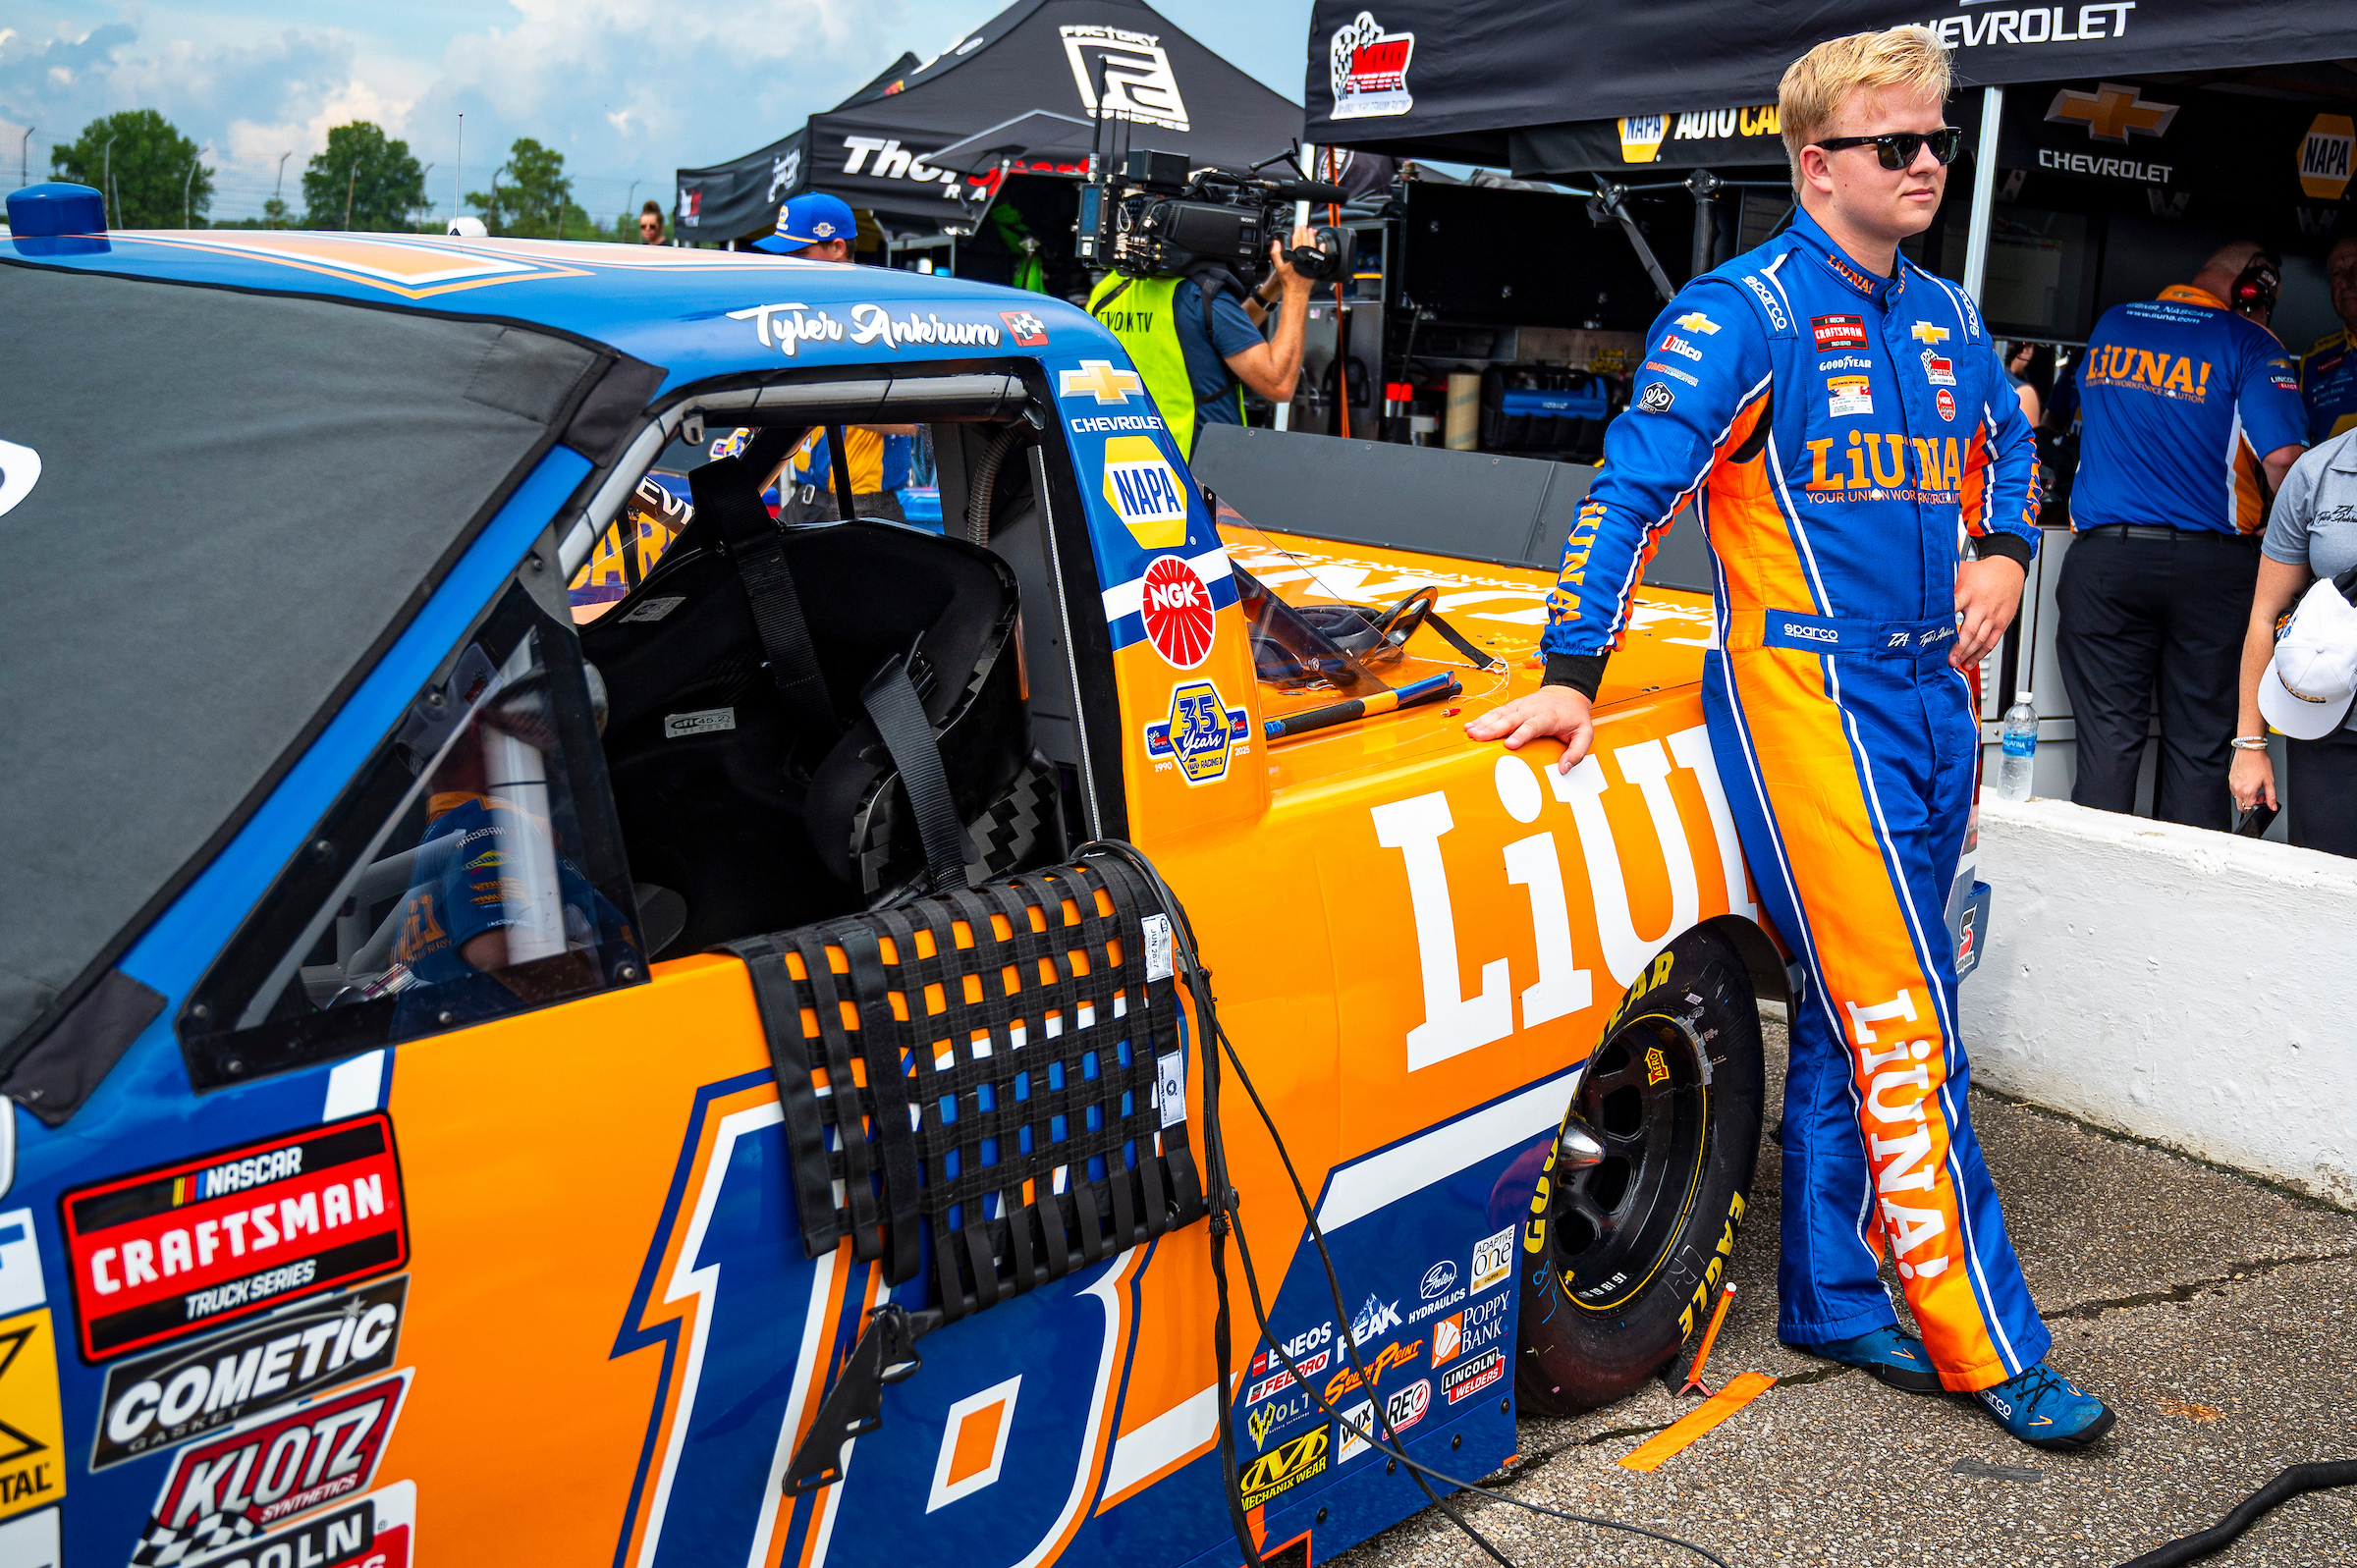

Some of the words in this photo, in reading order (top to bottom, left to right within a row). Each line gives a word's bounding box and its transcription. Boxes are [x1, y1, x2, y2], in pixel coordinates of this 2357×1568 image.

[1059, 26, 1160, 47] FACTORY
[1891, 2, 2135, 50] EVROLET
[1623, 115, 1664, 141] NAPA
[1673, 109, 1737, 140] AUTO
[1739, 105, 1782, 138] CA
[2039, 149, 2172, 184] CHEVROLET
[2303, 136, 2348, 177] NAPA
[1136, 311, 1153, 333] TV
[1741, 276, 1787, 332] sparco
[726, 302, 844, 356] Tyler
[850, 303, 1002, 351] Ankrum
[1659, 334, 1703, 362] Ullico
[1815, 326, 1863, 340] CRAFTSMAN
[1646, 361, 1668, 372] GMS
[1819, 355, 1872, 371] GOODYEAR
[2086, 344, 2212, 396] LiUNA!
[1070, 416, 1164, 433] CHEVROLET
[1114, 467, 1182, 516] NAPA
[1806, 493, 1844, 504] YOUR
[1546, 499, 1608, 626] iUNA!
[1150, 580, 1200, 613] NGK
[1783, 622, 1839, 643] sparco
[1178, 693, 1219, 737] 35
[1180, 730, 1223, 762] Years
[1234, 745, 1251, 756] 2025
[2003, 739, 2025, 749] QUAFINA
[1154, 762, 1173, 773] 1990
[1649, 1053, 1664, 1076] AERO
[1845, 989, 1949, 1280] LiUNA!
[205, 1147, 302, 1198] NASCAR
[90, 1173, 386, 1296] CRAFTSMAN
[1476, 1228, 1512, 1256] ADAPTIVE
[1474, 1243, 1510, 1275] one
[1677, 1190, 1745, 1345] EAGLE
[186, 1278, 249, 1321] TRUCK
[250, 1260, 316, 1302] SERIES
[1408, 1288, 1466, 1325] HYDRAULICS
[1462, 1290, 1510, 1331] POPPY
[1268, 1321, 1332, 1370] ENEOS
[1337, 1298, 1403, 1364] PEAK
[1460, 1317, 1503, 1355] BANK
[108, 1303, 397, 1445] COMETIC
[1263, 1353, 1327, 1396] FELPRO
[1445, 1353, 1495, 1389] LINCOLN
[1455, 1368, 1499, 1398] WELDERS
[1977, 1389, 2011, 1420] arco
[130, 1404, 244, 1452] GASKET
[1342, 1405, 1372, 1443] WIX
[171, 1396, 384, 1528] KLOTZ
[0, 1463, 53, 1503] TAL
[260, 1473, 358, 1522] SYNTHETICS
[1241, 1478, 1294, 1511] MECHANIX
[1296, 1456, 1327, 1484] WEAR
